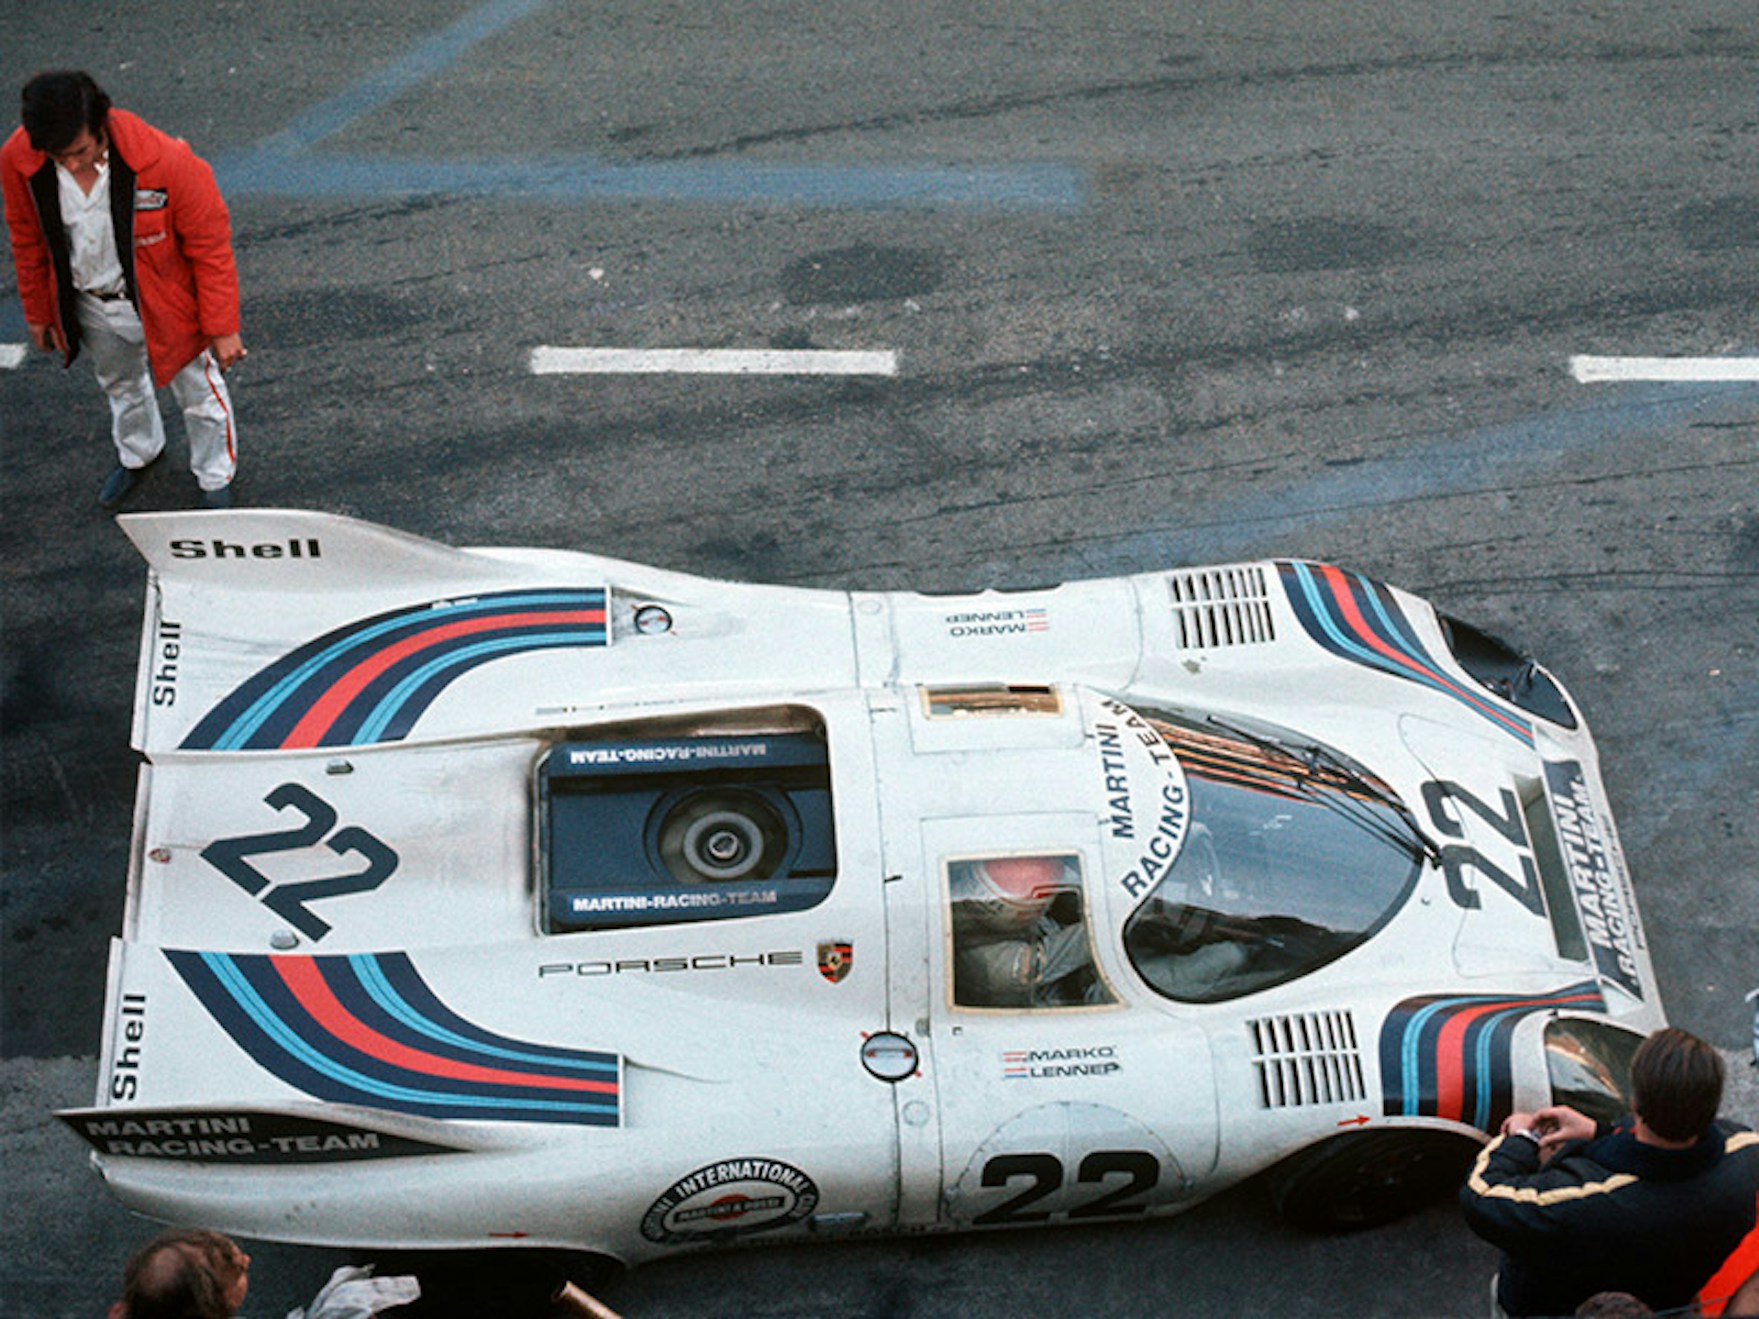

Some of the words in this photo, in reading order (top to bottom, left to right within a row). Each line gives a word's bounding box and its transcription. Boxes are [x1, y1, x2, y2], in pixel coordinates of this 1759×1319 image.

[170, 539, 321, 559] Shell
[950, 623, 1026, 637] MARKO
[153, 620, 181, 707] Shell
[571, 743, 767, 764] MARTINI-RACING-TEAM
[1095, 724, 1135, 839] MARTINI
[200, 782, 399, 943] 22
[1420, 780, 1548, 918] 22
[1552, 792, 1612, 949] MARTINI
[573, 890, 777, 911] MARTINI-RACING-TEAM
[539, 951, 803, 978] PORSCHE
[111, 993, 146, 1101] Shell
[1029, 1046, 1114, 1061] MARKO
[1030, 1062, 1121, 1078] LENNEP
[86, 1117, 250, 1137] MARTINI
[106, 1133, 380, 1156] RACING-TEAM
[675, 1160, 811, 1198] INTERNATIONAL
[973, 1152, 1160, 1225] 22
